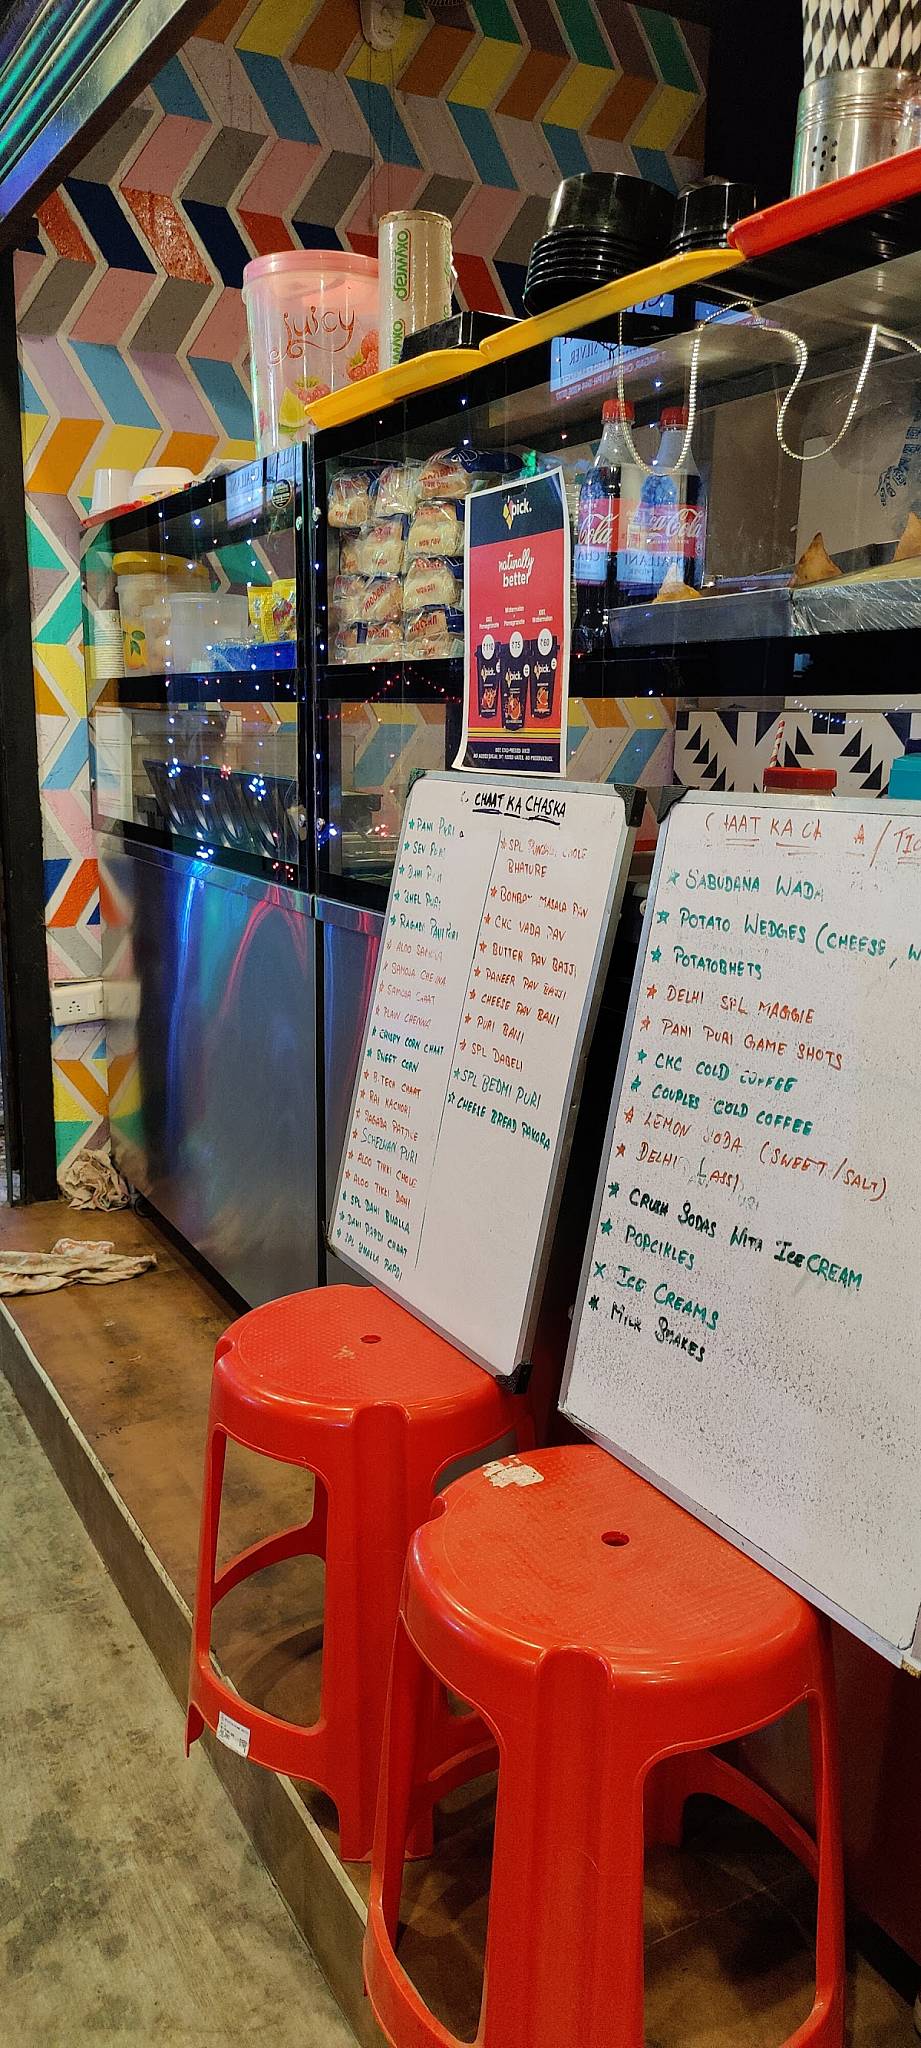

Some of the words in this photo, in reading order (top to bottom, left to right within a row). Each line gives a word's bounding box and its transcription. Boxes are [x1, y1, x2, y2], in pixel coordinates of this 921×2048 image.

[282, 306, 355, 359] juicy
[499, 548, 534, 575] naturally
[503, 573, 530, 588] better
[474, 793, 505, 808] CHAAT
[506, 795, 522, 814] KA
[525, 795, 566, 818] CHASKA
[417, 818, 434, 832] PANI
[770, 818, 793, 837] KA
[412, 841, 426, 855] SEV
[508, 839, 524, 853] SPL
[506, 858, 548, 878] BHATURE
[686, 869, 760, 893] SABUDANA
[494, 915, 512, 930] CKC
[519, 921, 541, 937] VADA
[679, 907, 731, 932] POTATO
[744, 912, 806, 944] WEDGES
[492, 942, 524, 963] BUTTER
[531, 952, 547, 966] PAV
[552, 957, 577, 977] BAJJI
[485, 968, 516, 986] PANEER
[522, 976, 539, 991] PAV
[543, 983, 567, 1001] BAJJI
[480, 993, 510, 1010] CHEESE
[516, 1002, 531, 1017] PAV
[667, 985, 704, 1004] DELHI
[720, 995, 748, 1015] SPL
[758, 1001, 815, 1024] MAGGIE
[477, 1015, 495, 1033] PURI
[404, 1037, 421, 1050] CORN
[662, 1018, 692, 1038] PANI
[703, 1025, 733, 1046] PURI
[744, 1034, 788, 1056] GAME
[797, 1042, 842, 1071] SHOTS
[401, 1059, 419, 1073] CORN
[471, 1042, 487, 1058] SPL
[492, 1047, 523, 1073] DABELI
[655, 1053, 682, 1072] CKC
[695, 1061, 730, 1081] COLD
[461, 1069, 477, 1088] SPL
[481, 1074, 512, 1098] BEDMI
[516, 1086, 542, 1110] PURI
[652, 1083, 700, 1110] COUPLES
[714, 1099, 749, 1118] COLD
[756, 1110, 813, 1136] COFFEE
[456, 1096, 487, 1118] CHEESE
[490, 1108, 518, 1134] BREAD
[521, 1121, 551, 1151] PAKORA
[644, 1112, 692, 1138] LEMON
[357, 1153, 372, 1168] ALOO
[400, 1145, 418, 1165] PURI
[636, 1141, 678, 1169] DELHI
[353, 1174, 369, 1189] ALOO
[396, 1190, 411, 1209] DAHI
[629, 1188, 669, 1217] CRUSH
[365, 1199, 380, 1215] DAHI
[348, 1214, 362, 1228] DAHI
[616, 1265, 647, 1293] ICE
[653, 1283, 719, 1331] CREAMS
